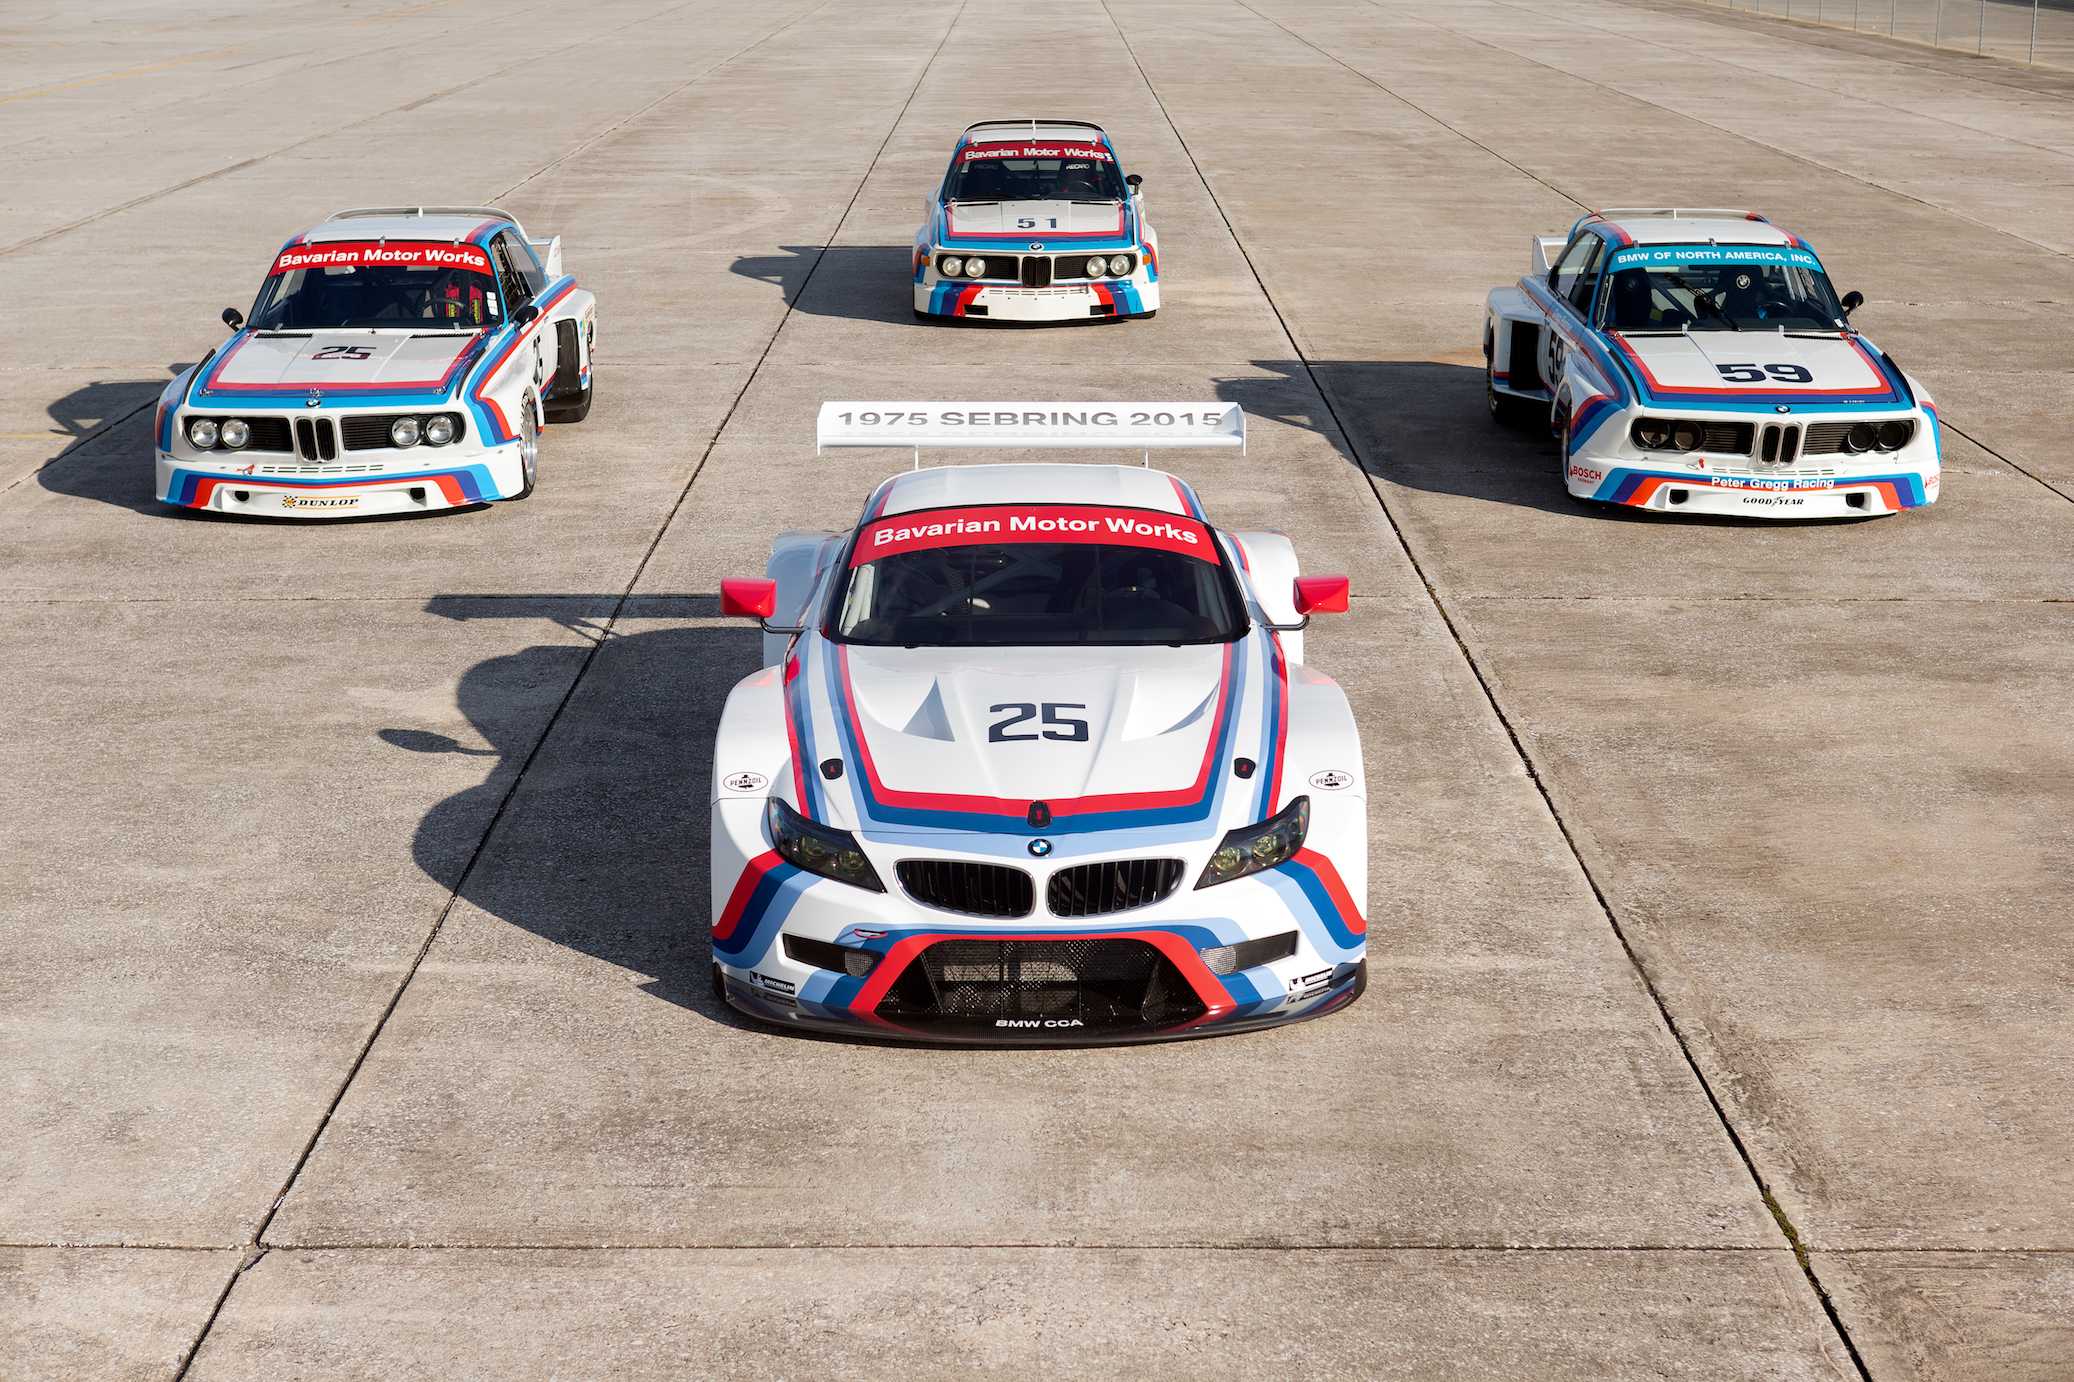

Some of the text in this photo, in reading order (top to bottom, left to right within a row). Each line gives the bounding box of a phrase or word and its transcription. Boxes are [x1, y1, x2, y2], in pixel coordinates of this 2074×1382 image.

[965, 148, 1105, 160] Bavarian Motor Works
[1017, 217, 1057, 229] 51
[279, 249, 485, 268] Bavarian Motor Works
[1618, 253, 1649, 264] BMW
[1654, 252, 1671, 260] OF
[1676, 251, 1721, 260] NORTH
[1791, 254, 1816, 265] INC.
[312, 346, 376, 360] 25
[1716, 364, 1813, 383] 59
[837, 411, 1223, 426] 1975 SEBRING 2015
[1573, 465, 1602, 480] BOSCH
[1711, 477, 1836, 491] Peter Gregg Racing
[298, 498, 359, 506] DUNLOP
[873, 516, 1199, 547] Bavarian Motor Works
[989, 703, 1089, 742] 25
[730, 778, 761, 786] PENNZOIL
[1316, 775, 1347, 785] PENNZOIL
[995, 1019, 1084, 1028] BMW CCA
